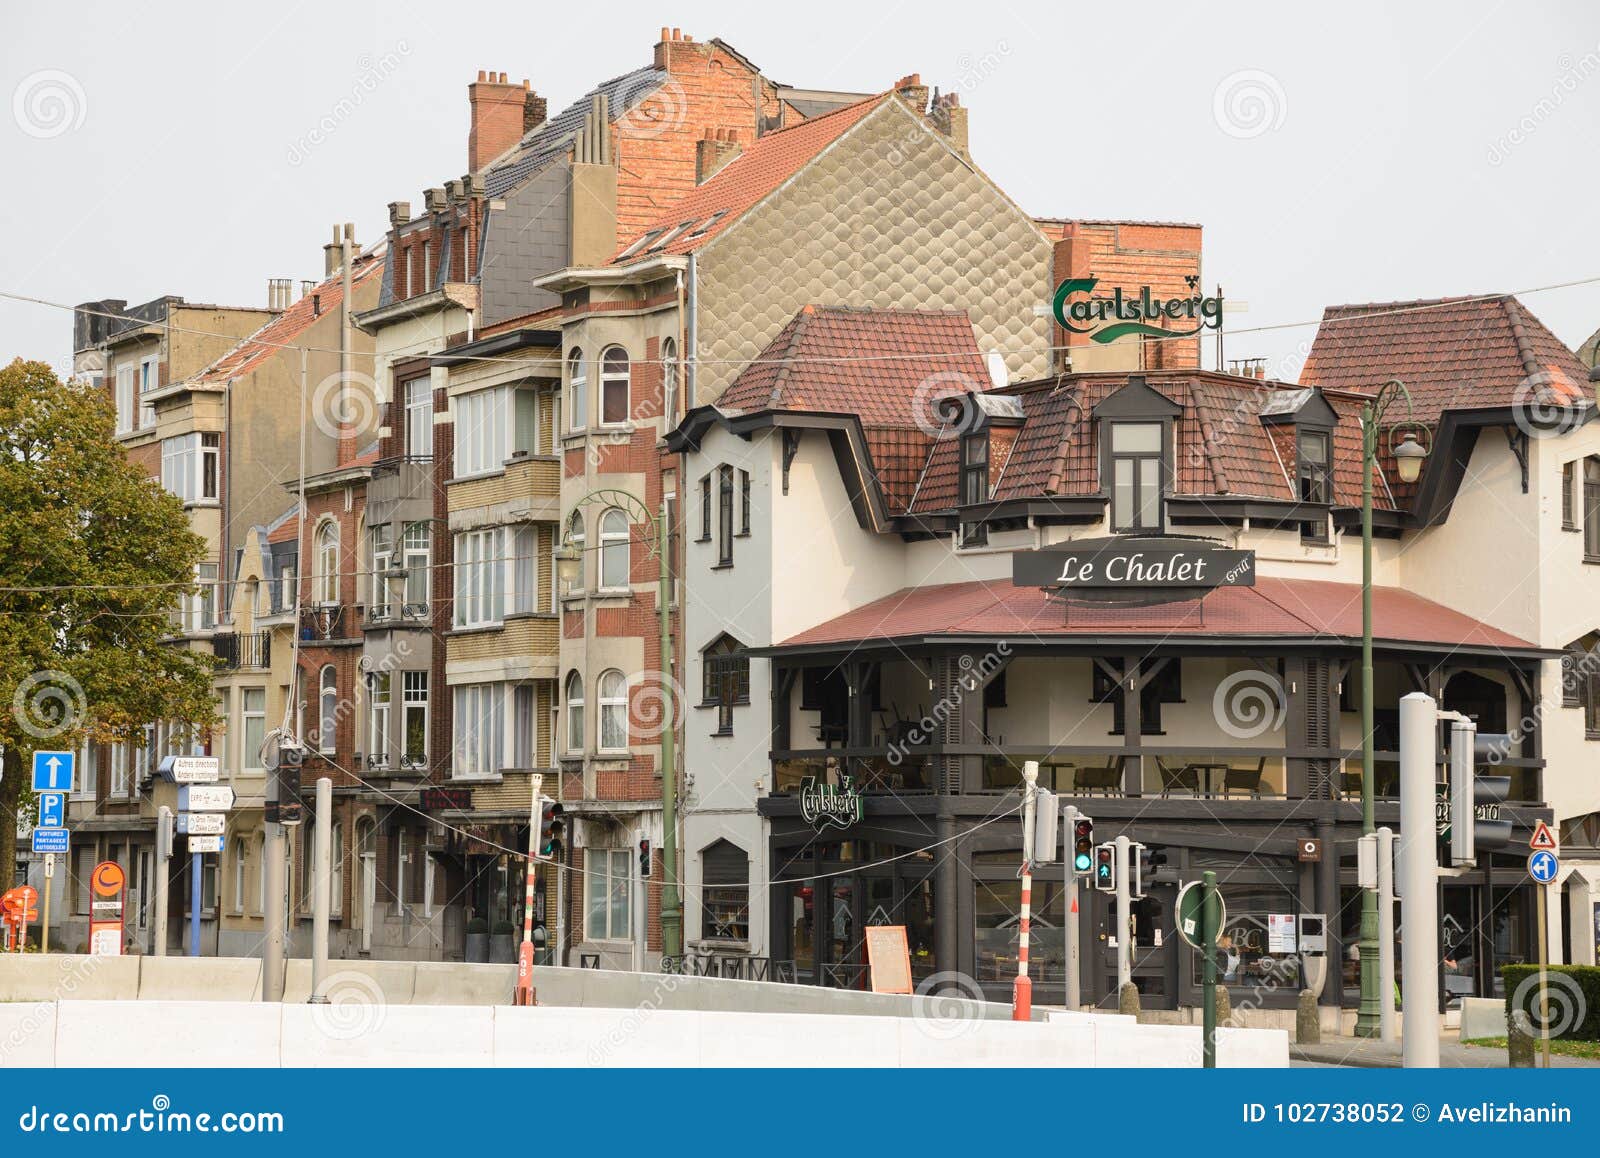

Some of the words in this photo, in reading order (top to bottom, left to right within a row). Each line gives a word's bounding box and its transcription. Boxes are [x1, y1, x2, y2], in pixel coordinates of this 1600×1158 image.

[1053, 278, 1224, 333] Carlsberg
[1057, 557, 1094, 582] Le
[1105, 553, 1207, 582] Chalet
[1226, 558, 1251, 584] Grill
[44, 795, 59, 814] P
[799, 775, 861, 823] Carlsberg
